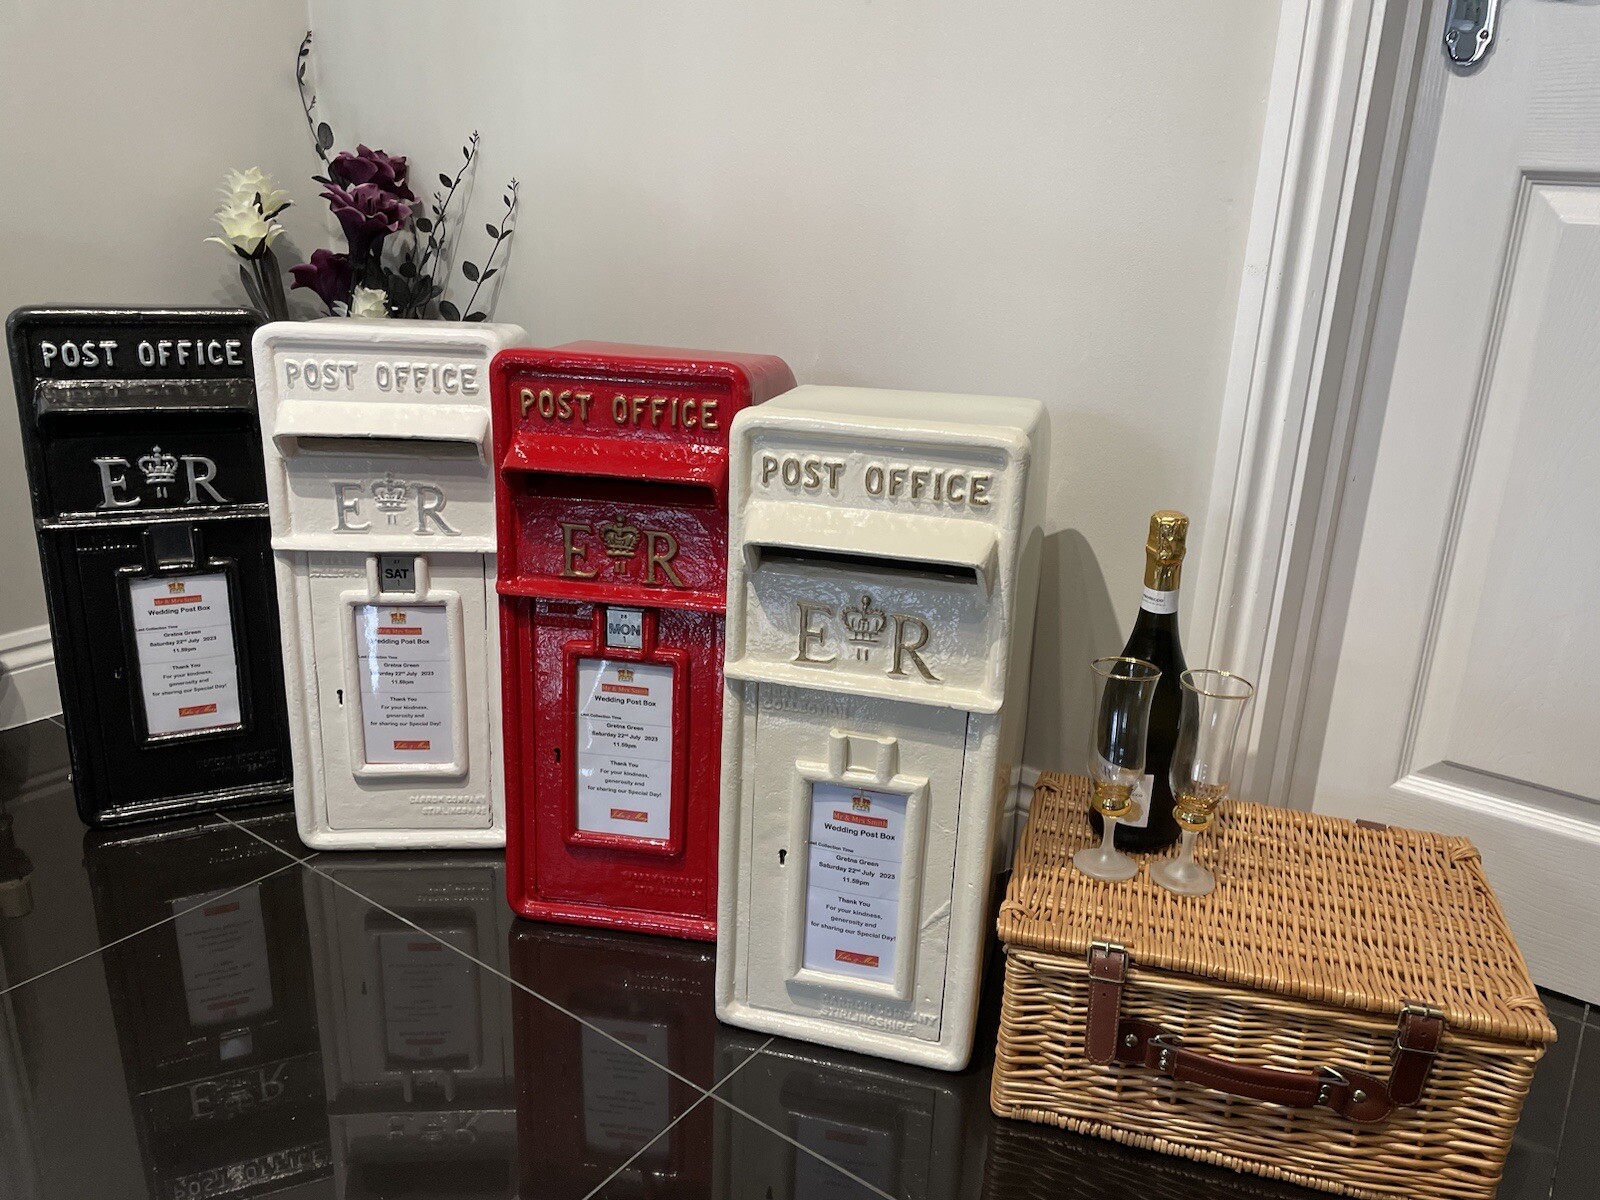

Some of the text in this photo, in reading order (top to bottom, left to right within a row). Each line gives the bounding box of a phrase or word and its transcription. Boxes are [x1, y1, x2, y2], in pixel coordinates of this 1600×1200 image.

[41, 339, 243, 367] POST OFFICE
[285, 360, 479, 395] POST OFFICE
[520, 388, 719, 429] POST OFFICE
[762, 455, 990, 506] POST OFFICE
[385, 569, 409, 579] SAT
[148, 608, 179, 616] Wedding
[608, 623, 641, 636] MON
[595, 695, 625, 705] Wedding
[627, 698, 642, 706] Post
[623, 771, 649, 779] kindness,
[834, 811, 843, 819] Mr
[852, 816, 865, 824] Mrs
[868, 818, 887, 827] Smith
[824, 823, 896, 841] Wedding Post Box
[818, 842, 841, 850] Collection
[836, 854, 879, 867] Gretna Green
[819, 861, 847, 872] Saturday
[862, 870, 875, 878] July
[879, 872, 895, 880] 2023
[843, 877, 869, 886] 11.59pm
[838, 896, 857, 905] Thank
[830, 916, 864, 927] generosity
[852, 910, 883, 920] kindness,
[821, 923, 844, 933] sharing
[857, 930, 880, 939] Special
[881, 934, 896, 942] Day!
